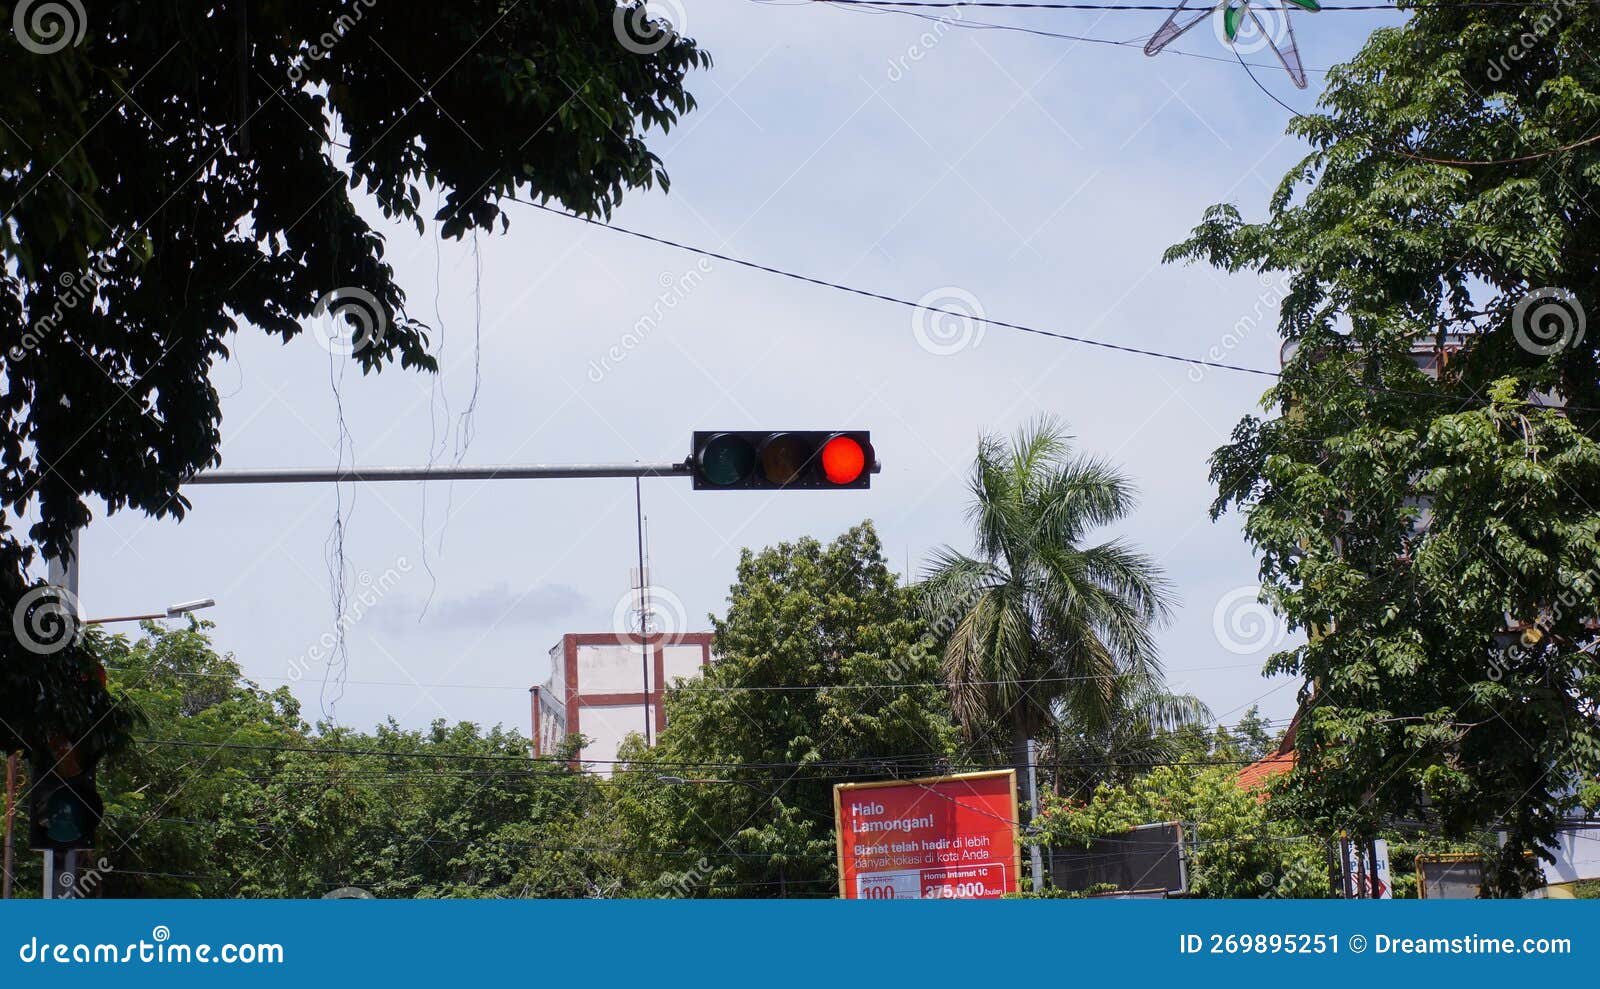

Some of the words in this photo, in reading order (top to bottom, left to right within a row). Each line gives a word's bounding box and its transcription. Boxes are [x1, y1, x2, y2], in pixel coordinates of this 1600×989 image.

[852, 802, 884, 816] Halo
[852, 814, 934, 833] Lamongan!
[855, 843, 889, 856] Biznet
[891, 841, 918, 853] telah
[922, 838, 950, 851] hadir
[953, 837, 962, 847] di
[965, 836, 990, 847] lebih
[855, 855, 891, 869] banyak
[893, 854, 922, 866] lokasi
[925, 851, 934, 863] di
[937, 851, 959, 862] kota
[962, 849, 989, 861] Anda
[924, 871, 946, 881] Home
[947, 869, 976, 879] Internet
[863, 886, 895, 899] 100
